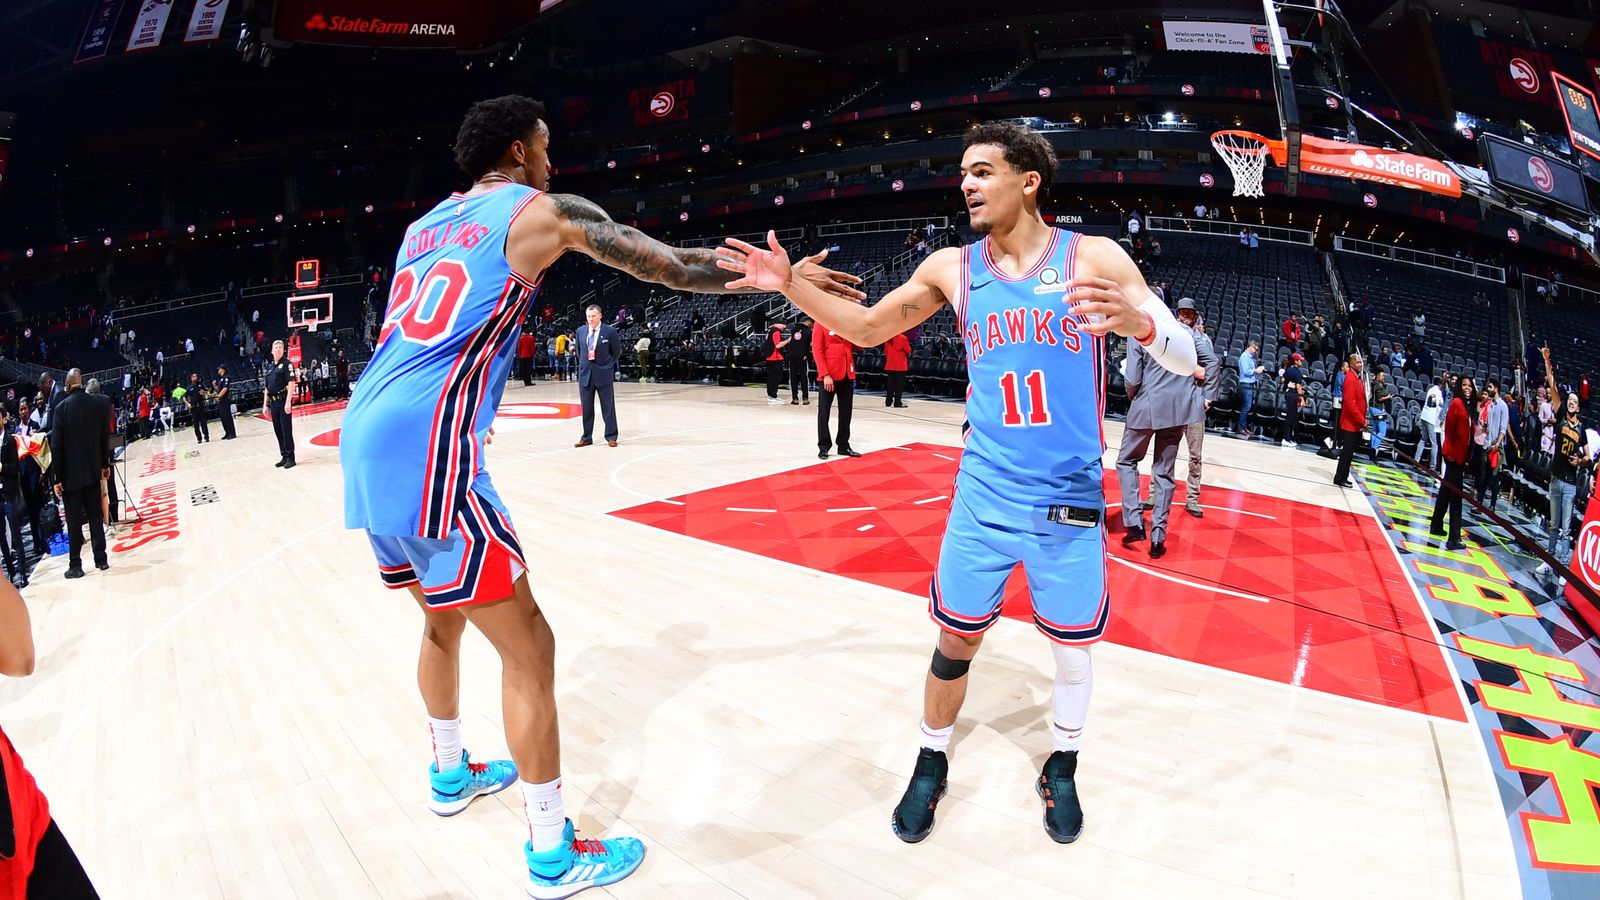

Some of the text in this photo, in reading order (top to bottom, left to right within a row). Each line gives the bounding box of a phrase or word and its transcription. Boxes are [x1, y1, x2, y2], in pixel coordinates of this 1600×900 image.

[410, 24, 455, 35] ARENA
[406, 222, 490, 260] COLLINS
[1056, 215, 1083, 223] ARENA
[377, 257, 473, 347] 20
[967, 308, 1081, 362] HAWKS
[1000, 368, 1052, 428] 11
